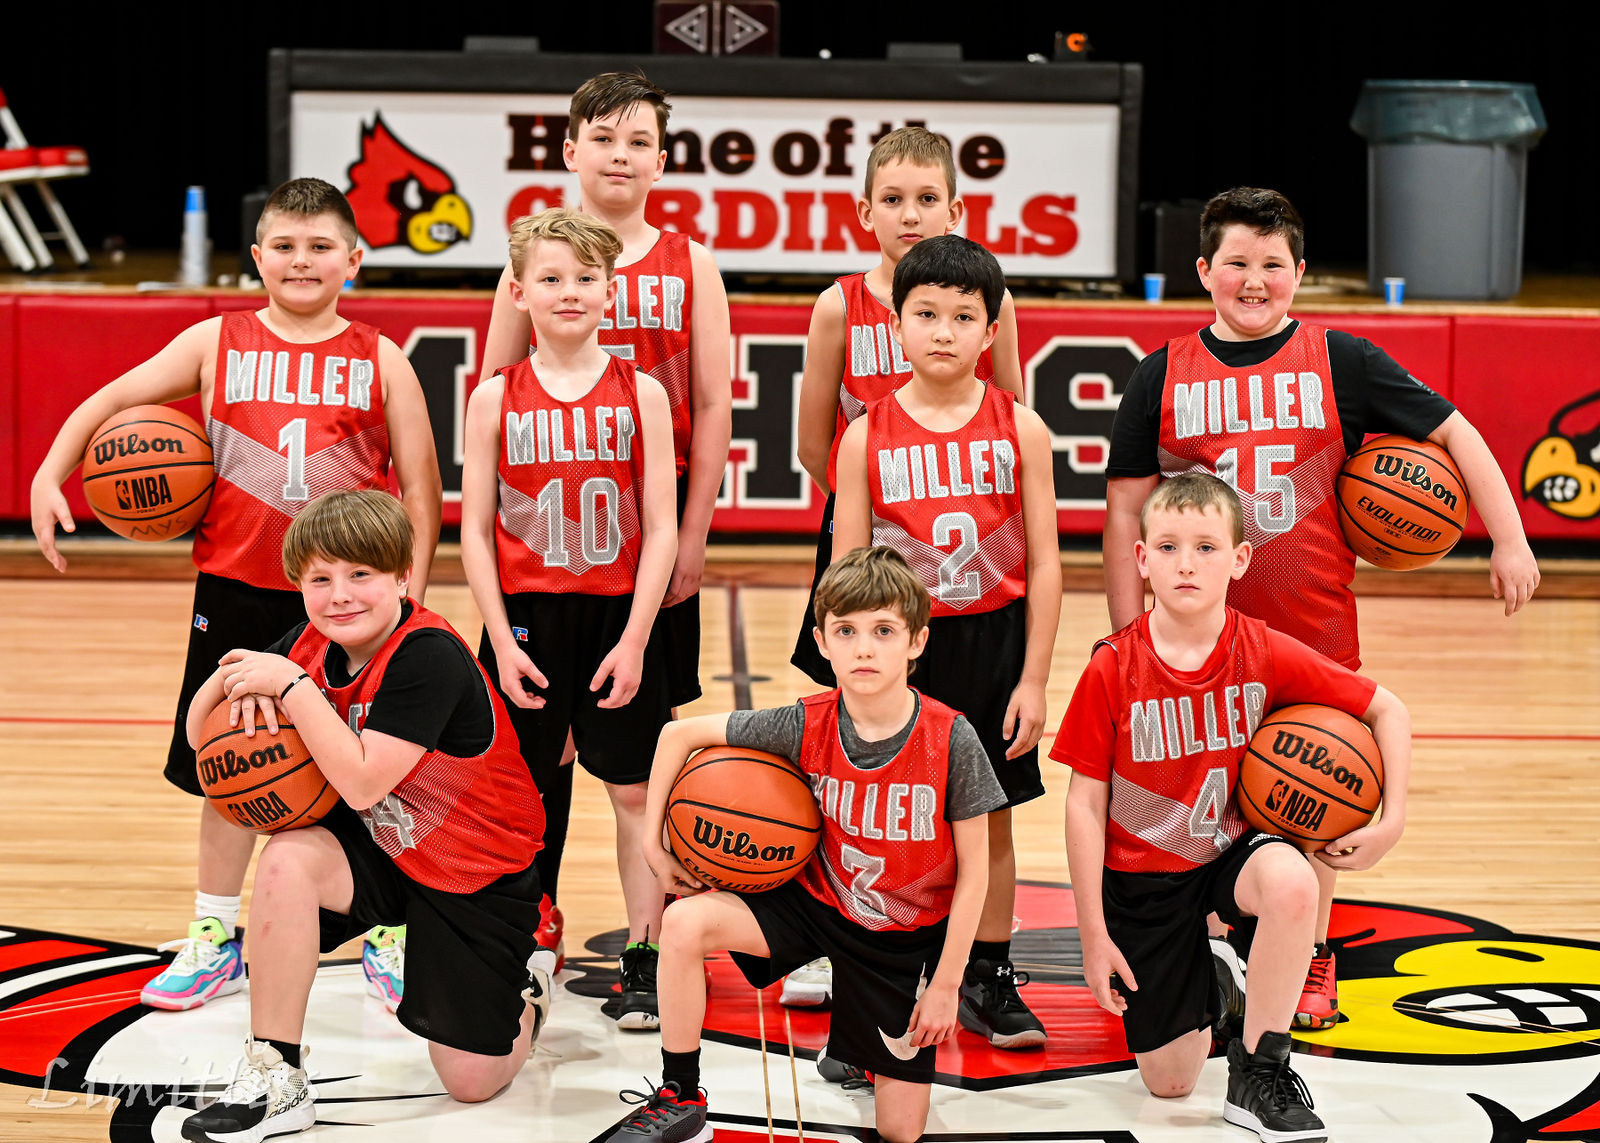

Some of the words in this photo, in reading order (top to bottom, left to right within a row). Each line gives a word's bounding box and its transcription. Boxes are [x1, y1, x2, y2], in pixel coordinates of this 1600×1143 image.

[507, 113, 756, 175] Hme
[772, 117, 854, 176] of
[225, 349, 375, 411] MILLER
[1173, 371, 1327, 440] MILLER
[94, 433, 187, 465] Wilson
[278, 418, 309, 501] 1
[505, 406, 636, 466] MILLER
[131, 473, 173, 509] NBA
[877, 439, 1016, 505] MILLER
[1373, 453, 1459, 512] Wilson
[536, 477, 622, 567] 10
[1357, 496, 1442, 542] EVOLUTION
[932, 511, 982, 602] 2
[1130, 681, 1267, 763] MILLER
[199, 742, 288, 787] Wilson
[1272, 730, 1364, 797] Wilson
[242, 790, 293, 826] NBA
[692, 815, 796, 862] Wilson
[1188, 767, 1233, 851] 4
[1280, 791, 1329, 832] NBA
[841, 843, 889, 920] 3
